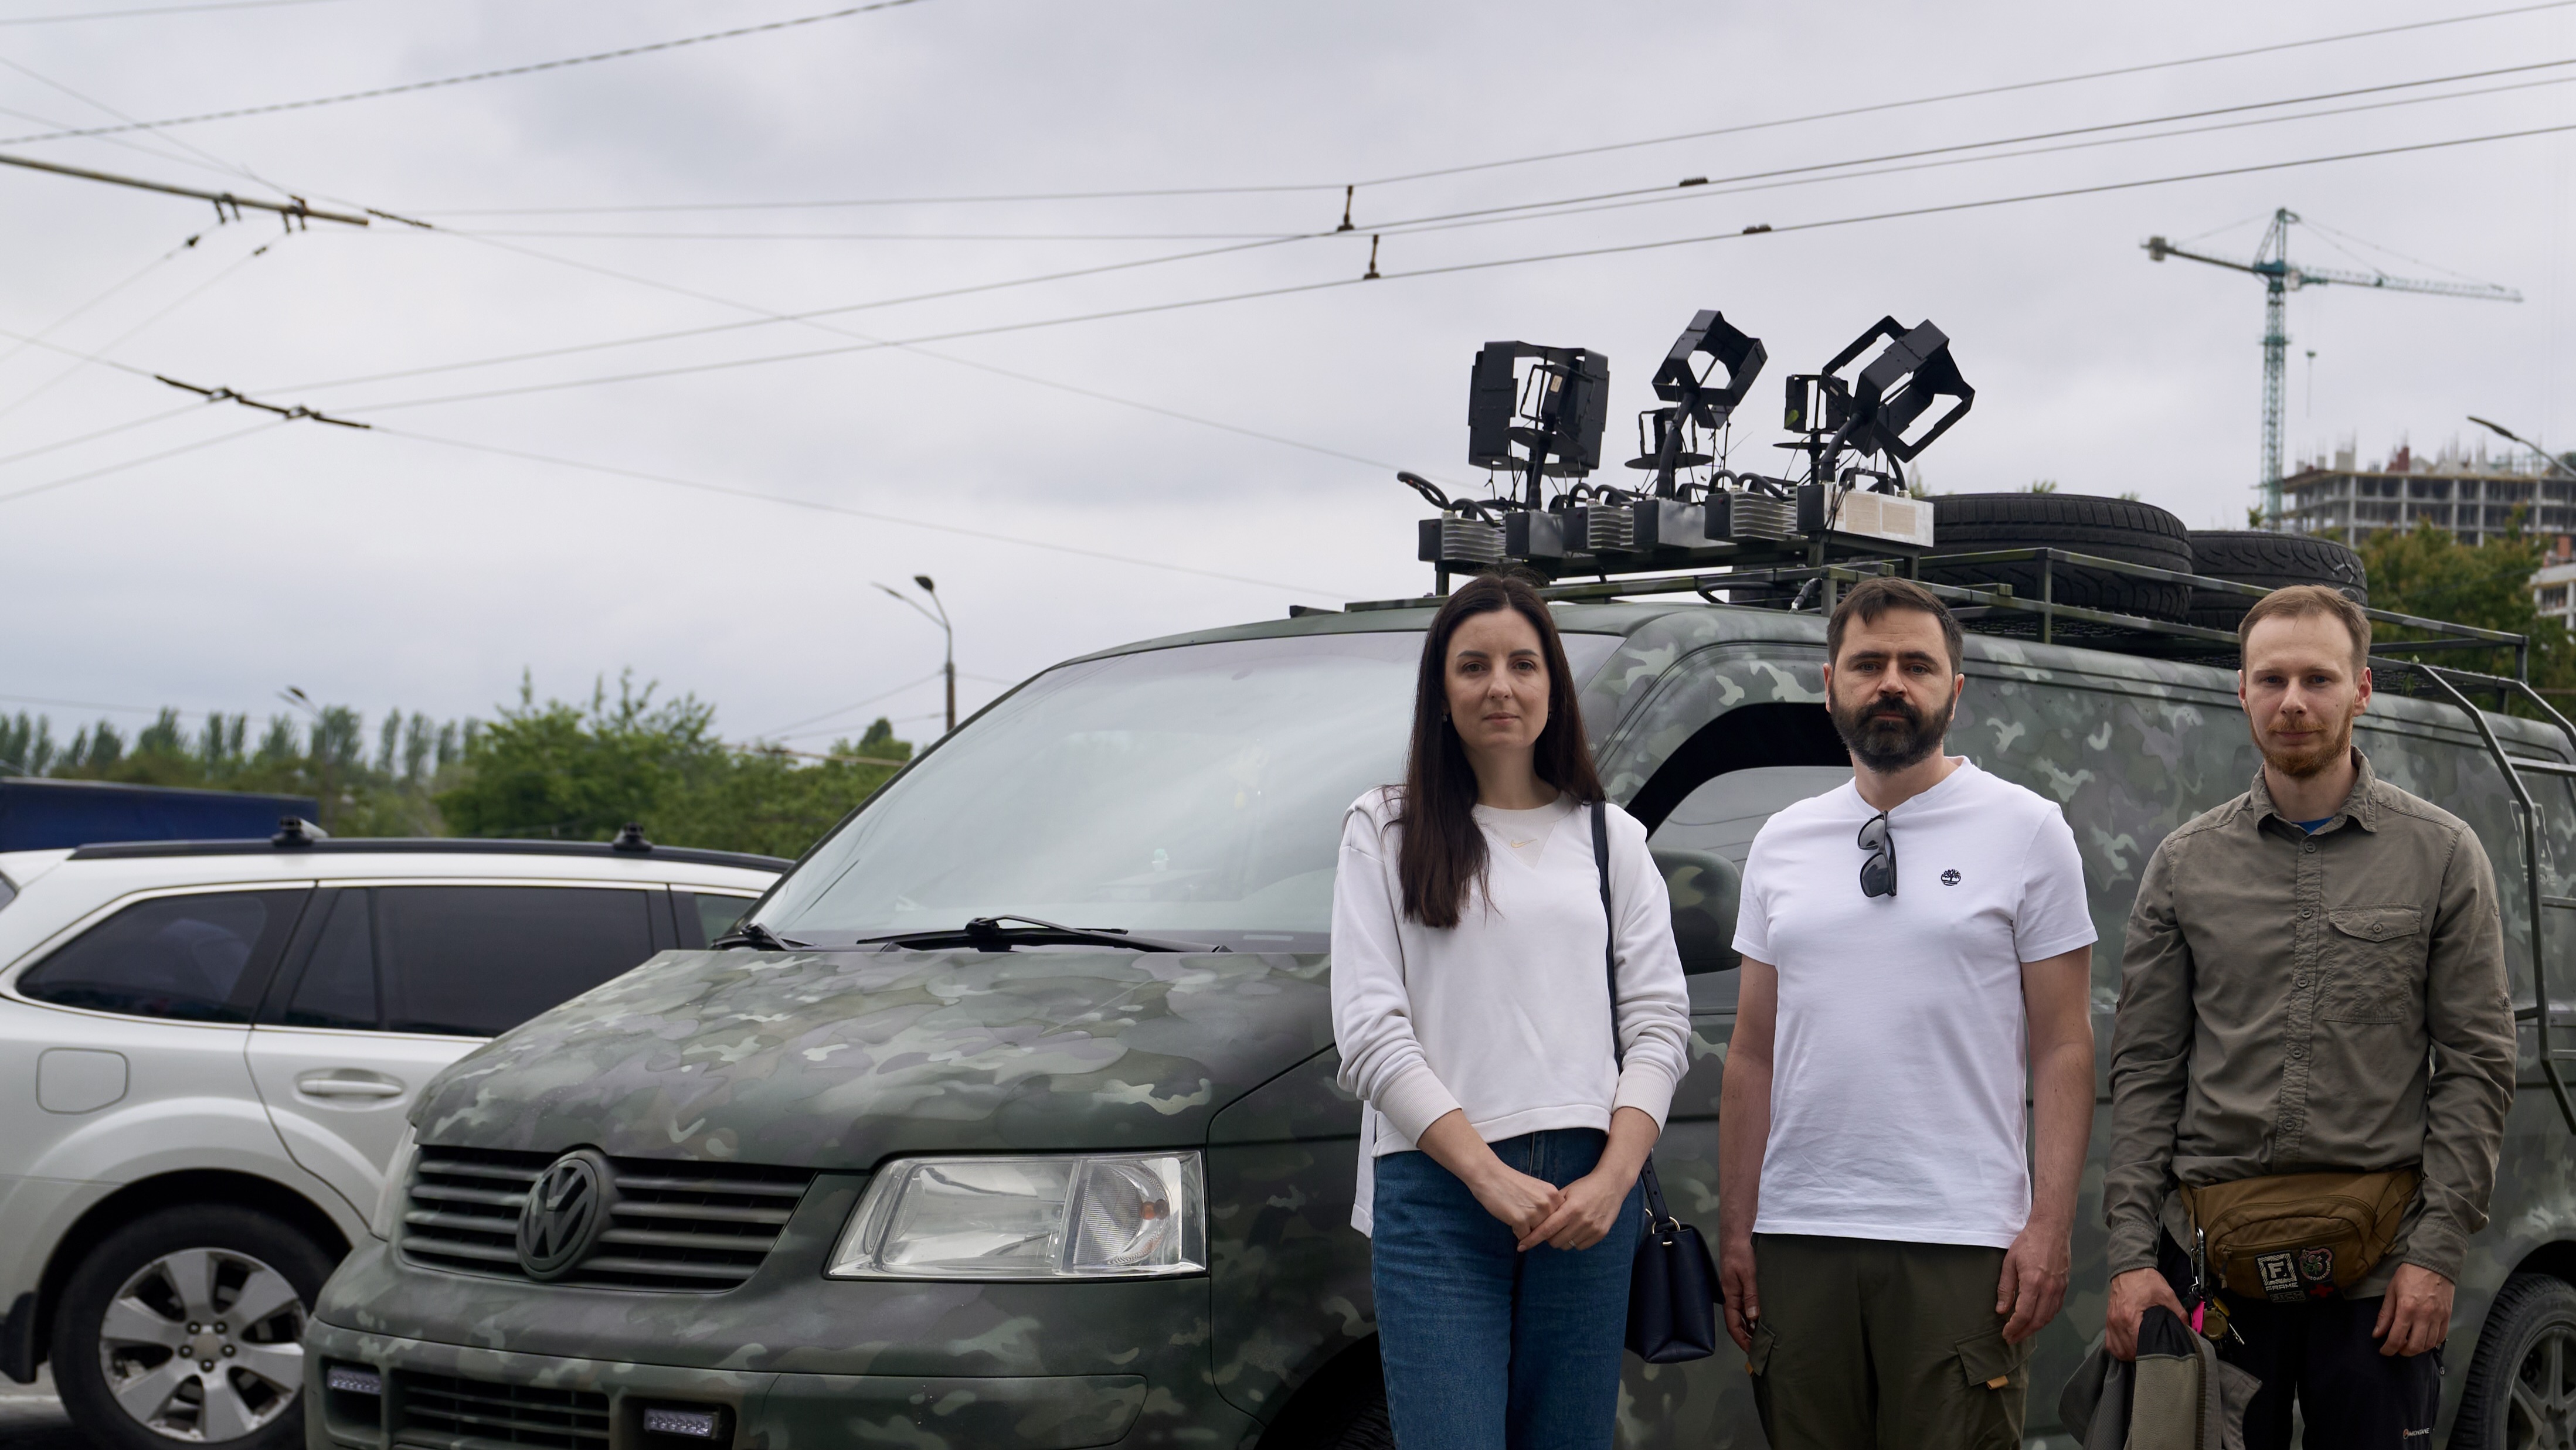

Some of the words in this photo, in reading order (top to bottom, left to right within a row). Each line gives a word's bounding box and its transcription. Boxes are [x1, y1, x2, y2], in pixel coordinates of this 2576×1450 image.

[2523, 872, 2557, 886] FAME
[522, 1159, 594, 1269] VW
[2265, 1282, 2299, 1292] FRAME
[2410, 1428, 2430, 1436] MONTANE
